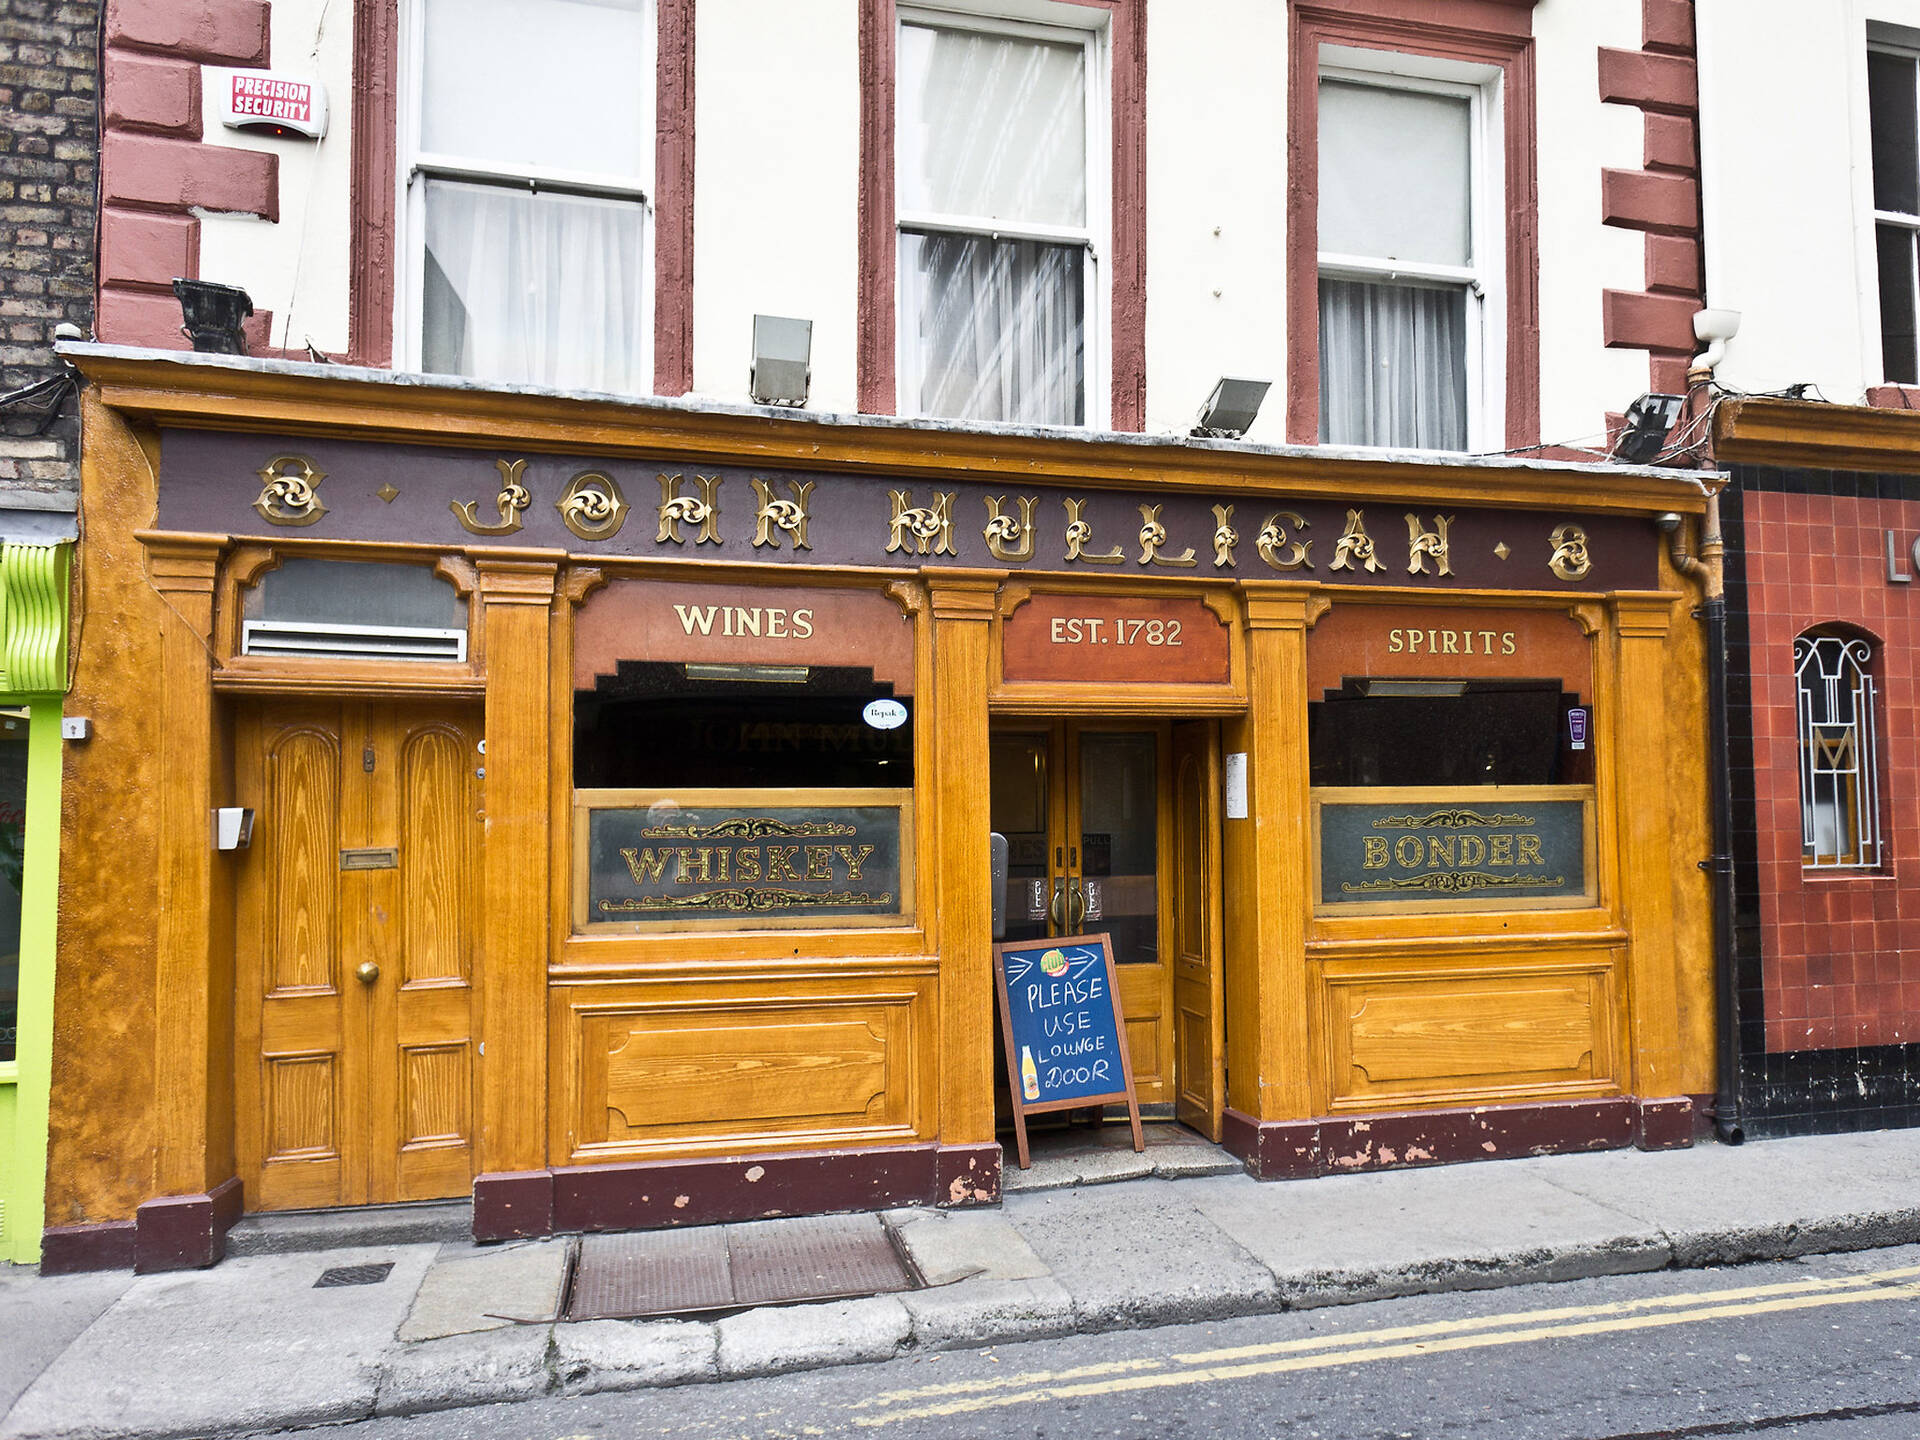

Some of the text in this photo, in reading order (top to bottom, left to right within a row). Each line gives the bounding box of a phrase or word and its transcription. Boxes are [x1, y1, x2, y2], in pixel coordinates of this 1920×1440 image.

[234, 77, 309, 102] PRECISION
[234, 96, 309, 121] SECURITY
[451, 458, 814, 550] JOHN
[885, 489, 1457, 576] MULLIGAN
[1884, 529, 1920, 584] L
[672, 604, 814, 639] WINES
[1050, 617, 1183, 646] EST. 1782
[1388, 629, 1517, 655] SPIRITS
[620, 845, 875, 885] WHISKEY
[1362, 834, 1544, 869] BONDER
[1027, 977, 1102, 1013] PLEASE
[1044, 1011, 1091, 1037] USE
[1038, 1035, 1105, 1064] LOUNGE
[1045, 1059, 1110, 1088] DOOR
